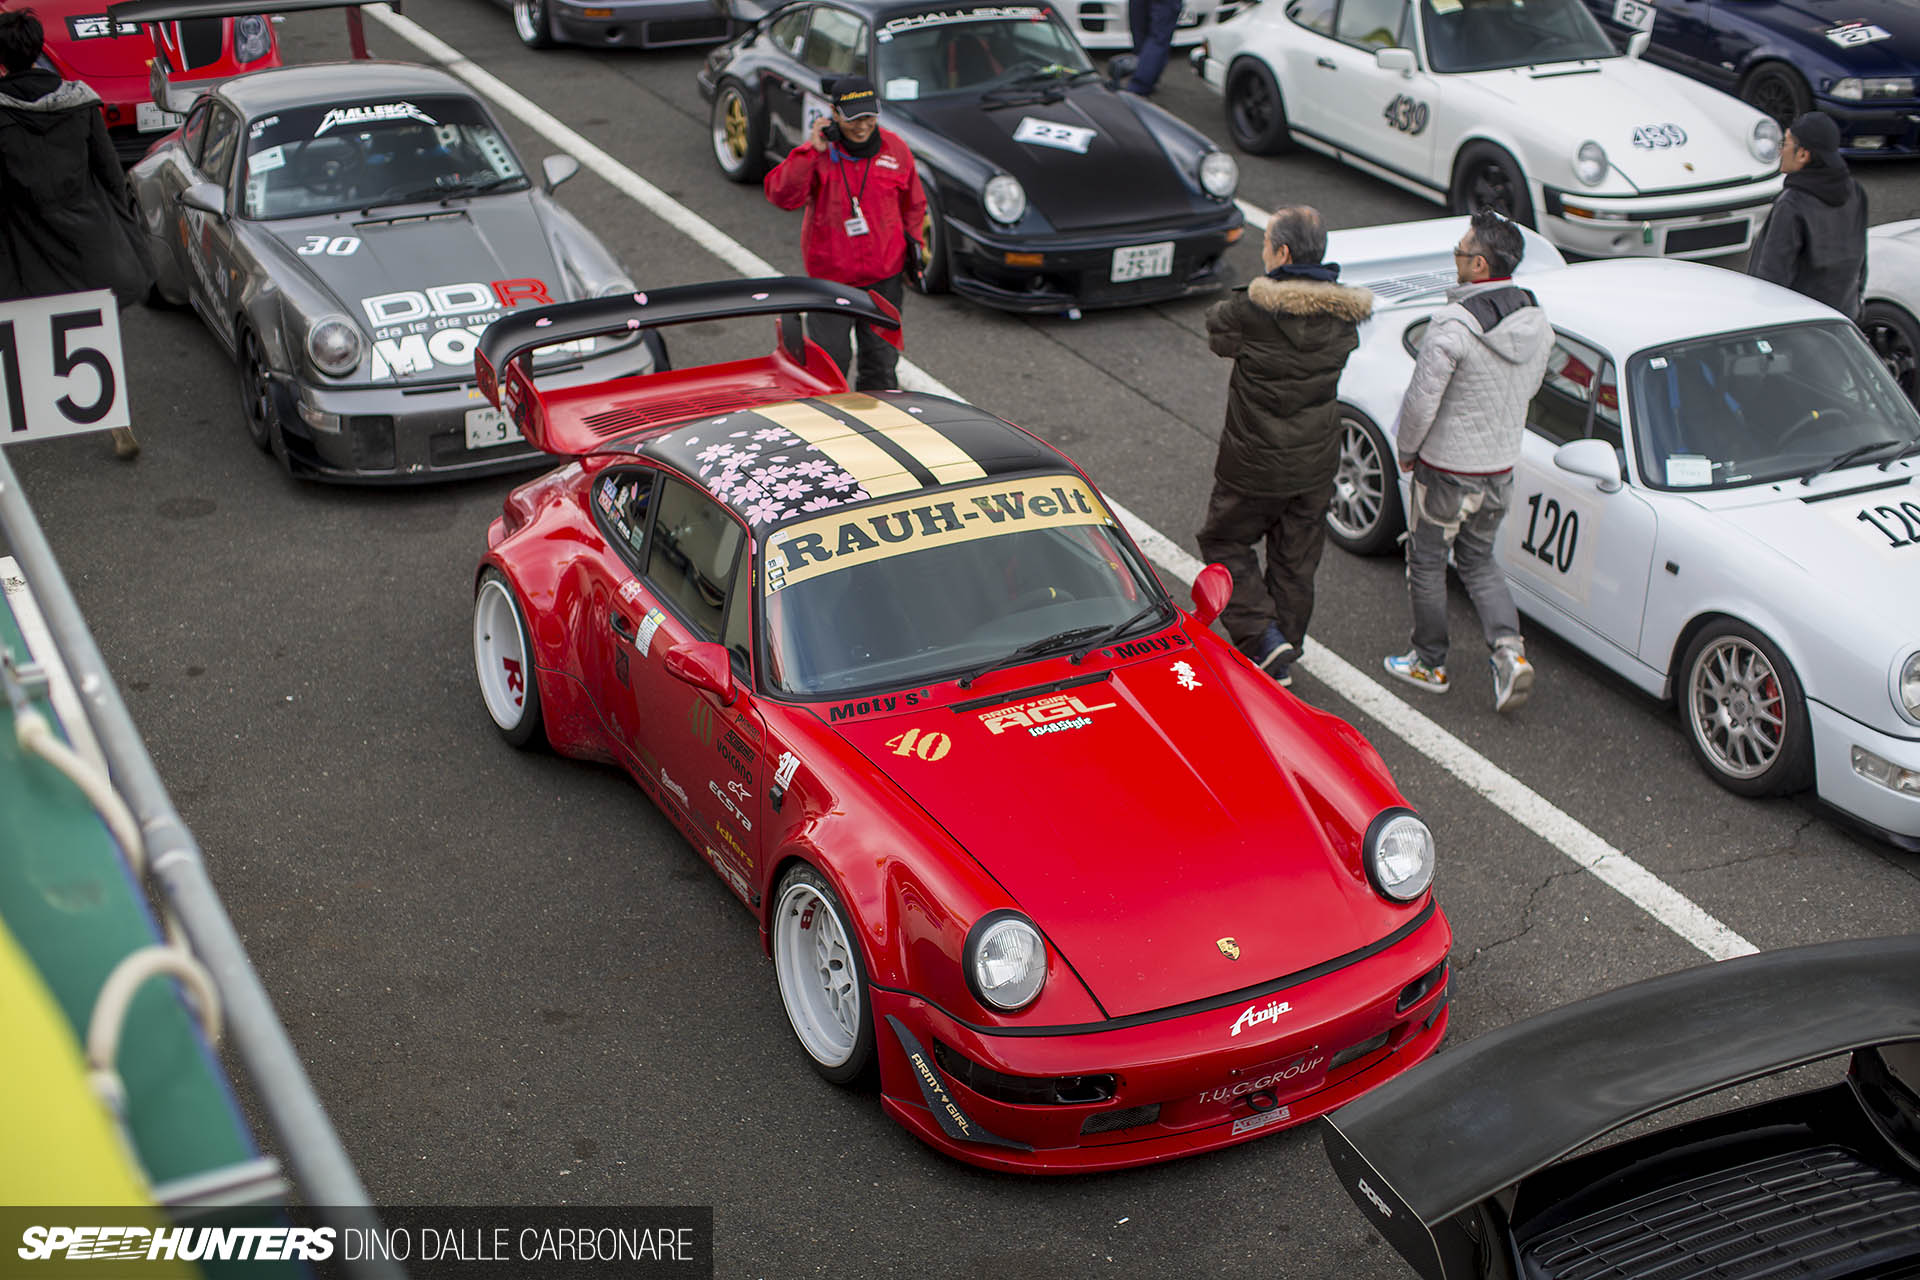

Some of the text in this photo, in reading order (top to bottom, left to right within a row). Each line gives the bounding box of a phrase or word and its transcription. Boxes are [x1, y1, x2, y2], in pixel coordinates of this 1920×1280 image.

[1621, 2, 1649, 25] 27
[1383, 93, 1430, 136] 439
[1033, 125, 1073, 141] 22
[1632, 122, 1688, 149] 439
[296, 235, 362, 257] 30
[0, 308, 116, 434] 15
[777, 487, 1093, 573] RAUH-Welt
[1520, 492, 1579, 574] 120
[1114, 634, 1187, 660] Moty's
[829, 692, 919, 722] Moty's
[977, 703, 1025, 722] ARMY
[984, 696, 1117, 735] AGL
[885, 728, 952, 762] 40
[1229, 1000, 1294, 1037] Anija
[911, 1052, 971, 1137] ARMY GIRL
